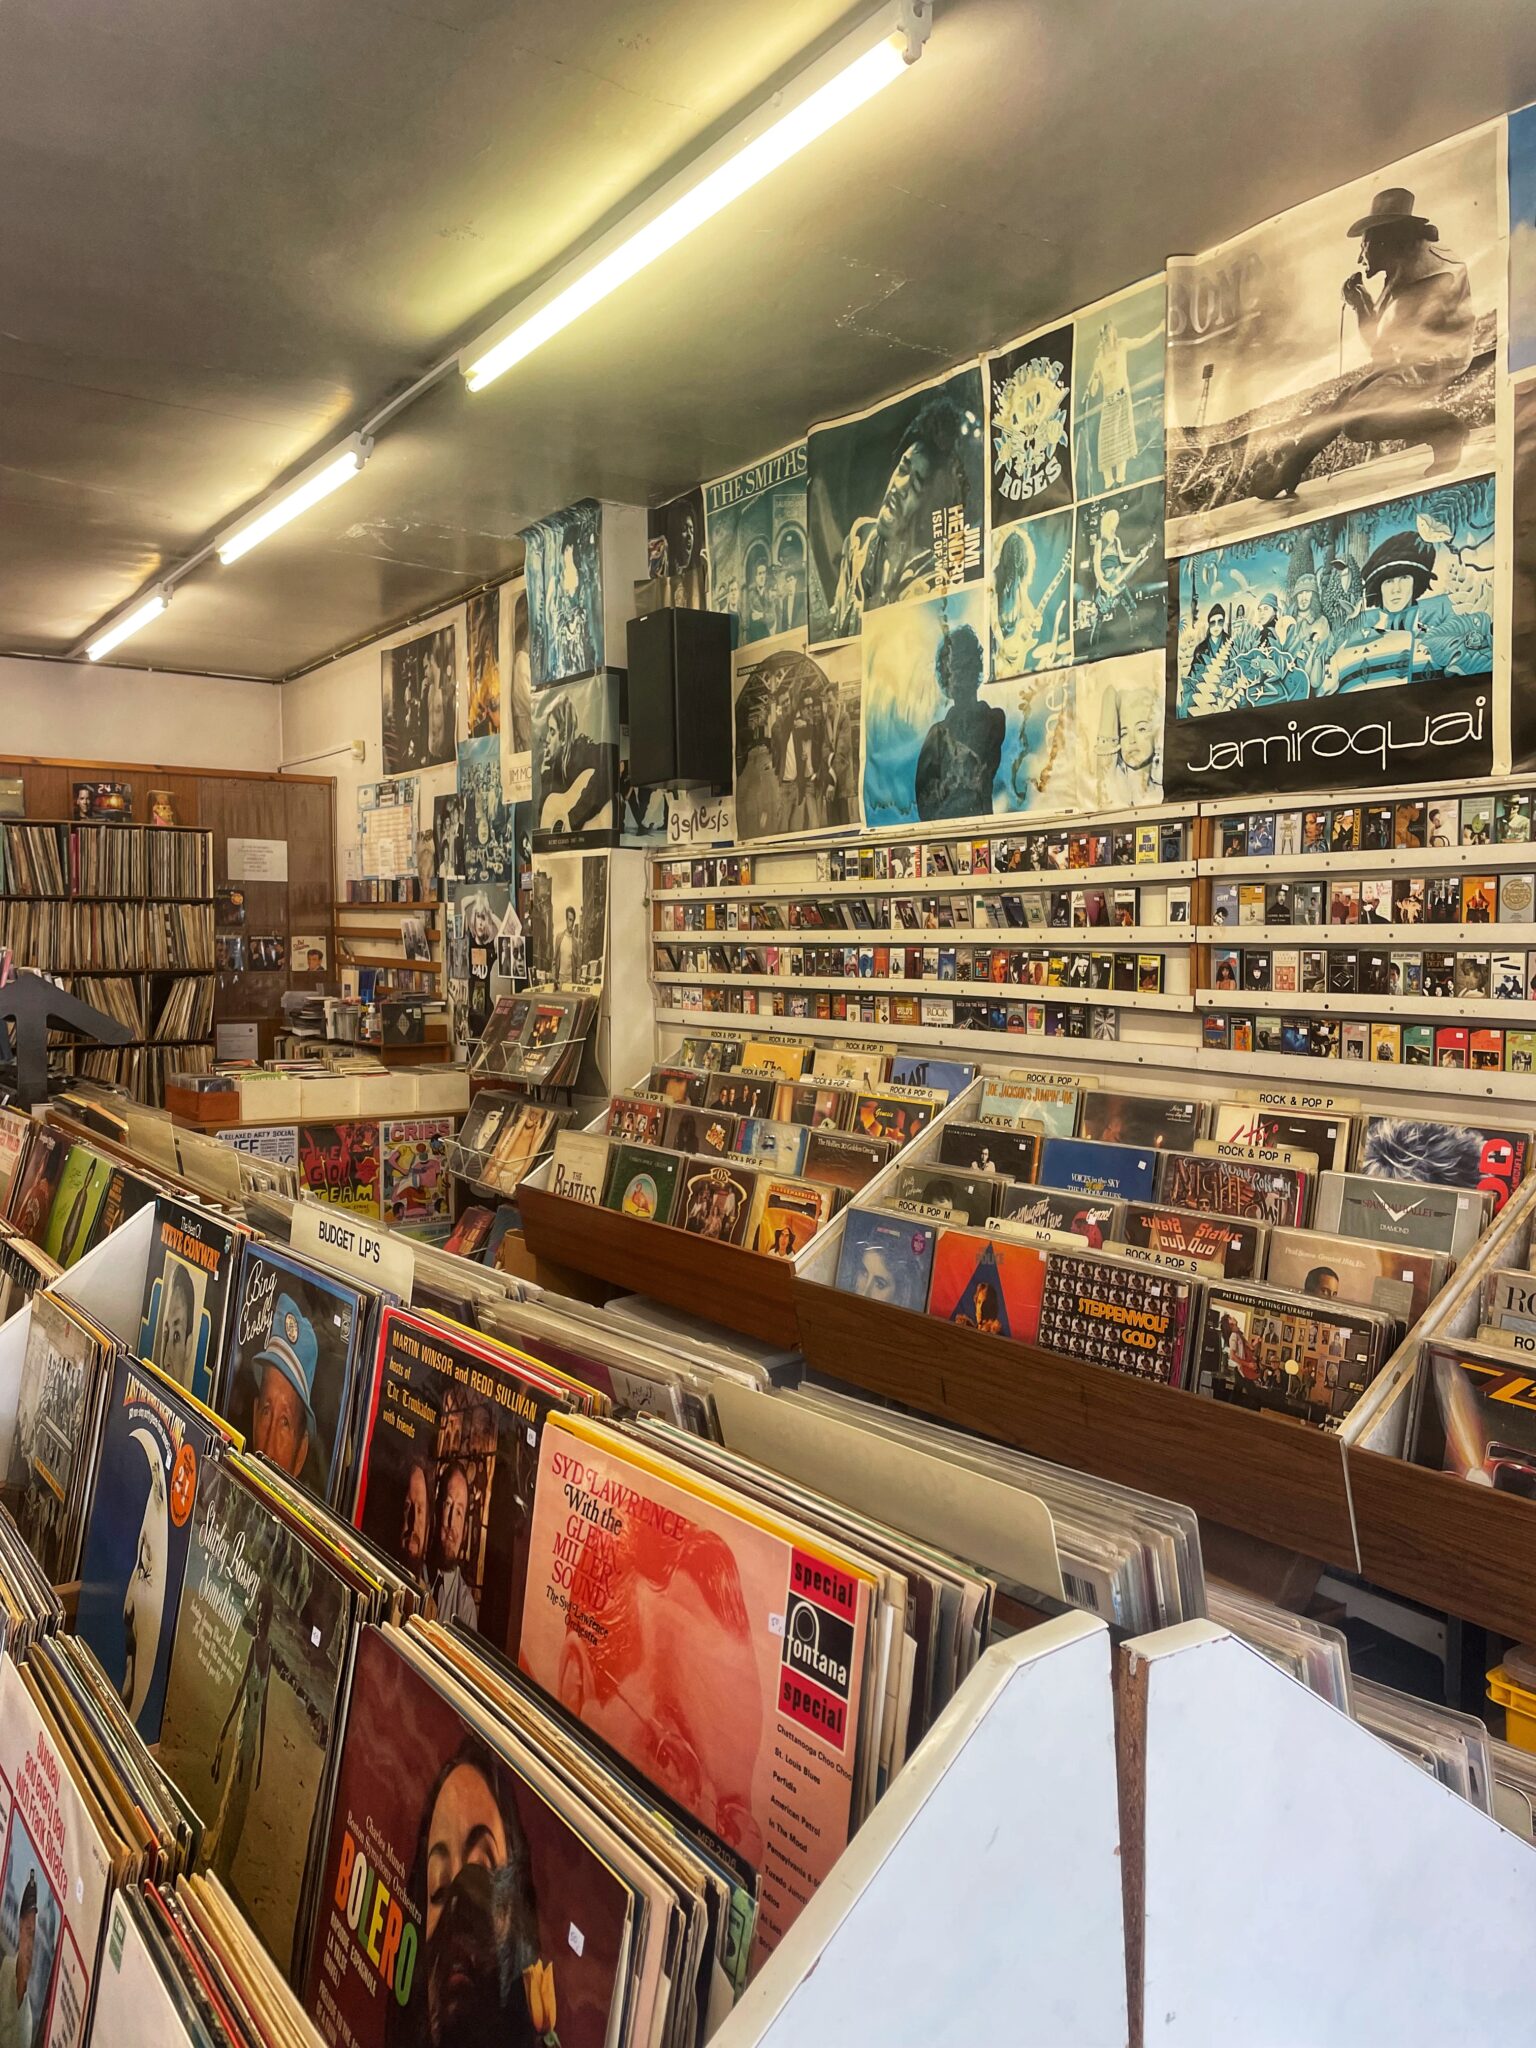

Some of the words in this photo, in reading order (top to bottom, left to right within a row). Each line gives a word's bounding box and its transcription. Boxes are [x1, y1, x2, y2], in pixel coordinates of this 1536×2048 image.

[710, 474, 743, 509] THE
[745, 446, 808, 494] SMITHS
[998, 456, 1062, 501] ROSES
[963, 523, 980, 569] JIMI
[670, 799, 729, 842] genesis
[890, 1086, 905, 1095] ROCK
[913, 1088, 925, 1097] POP
[985, 1082, 998, 1097] JOE
[999, 1082, 1032, 1100] JACKSON'S
[1026, 1073, 1046, 1083] ROCK
[1057, 1076, 1072, 1085] POP
[1259, 1093, 1286, 1106] ROCK
[1302, 1097, 1323, 1108] POP
[391, 1122, 451, 1142] CRIBS
[875, 1107, 894, 1118] Genesis
[224, 1132, 251, 1141] RELAXED
[253, 1130, 270, 1138] ARTY
[1217, 1144, 1244, 1157] ROCK
[1258, 1149, 1279, 1161] POP
[553, 1163, 597, 1205] BEATLES
[572, 1171, 582, 1181] THE
[1071, 1172, 1091, 1184] VOICES
[1107, 1178, 1120, 1188] SKY
[1511, 1140, 1525, 1194] AMOUFLAGE
[898, 1200, 917, 1211] ROCK
[926, 1207, 941, 1216] POP
[1379, 1223, 1410, 1234] DIAMOND
[161, 1222, 184, 1253] STEVE
[184, 1234, 220, 1273] CONWAY
[318, 1220, 355, 1252] BUDGET
[358, 1236, 380, 1263] LP'S
[1188, 1237, 1216, 1255] Quo
[1194, 1222, 1243, 1243] Status
[1125, 1248, 1152, 1261] ROCK
[1165, 1256, 1185, 1269] POP
[244, 1259, 278, 1311] Bing
[1222, 1291, 1232, 1299] PAT
[1232, 1293, 1256, 1305] TRAVERS
[1257, 1299, 1281, 1311] PUTTING
[1287, 1305, 1314, 1318] STRAIGHT
[238, 1300, 274, 1350] Crosby
[1077, 1298, 1169, 1335] STEPPENWOLF
[1121, 1328, 1157, 1350] GOLD
[392, 1329, 420, 1359] MARTIN
[421, 1345, 453, 1378] WINSOR
[454, 1362, 470, 1384] and
[470, 1368, 494, 1398] REDD
[495, 1383, 538, 1423] SULLIVAN
[404, 1366, 412, 1381] of
[395, 1416, 416, 1439] friends
[551, 1451, 585, 1486] SYD
[586, 1468, 687, 1541] LAWRENCE
[564, 1483, 600, 1525] With
[601, 1501, 623, 1536] the
[199, 1500, 230, 1577] Shirley
[566, 1514, 622, 1576] GLENN
[225, 1531, 261, 1611] Bassey
[551, 1560, 608, 1612] SOUND
[552, 1532, 614, 1600] MILLER
[794, 1560, 854, 1609] special
[546, 1585, 559, 1606] The
[559, 1594, 572, 1615] Syd
[572, 1603, 609, 1639] Lawrence
[564, 1613, 598, 1646] Orchestra
[786, 1600, 847, 1687] fontana
[783, 1681, 844, 1734] special
[36, 1730, 61, 1801] Sunday
[776, 1723, 817, 1758] Chattanooga
[817, 1750, 835, 1770] Choo
[835, 1762, 852, 1782] Choo
[785, 1753, 802, 1772] Louis
[803, 1765, 821, 1785] Blues
[24, 1750, 37, 1782] and
[37, 1772, 53, 1823] every
[52, 1805, 66, 1852] day
[772, 1770, 797, 1795] Perfidia
[768, 1817, 775, 1829] In
[776, 1822, 788, 1839] The
[789, 1833, 808, 1854] Mood
[770, 1794, 800, 1823] American
[801, 1814, 821, 1838] Patrol
[28, 1794, 47, 1844] Frank
[45, 1829, 69, 1900] Sinatra
[346, 1809, 365, 1845] Boston
[364, 1834, 392, 1886] Symphony
[392, 1875, 422, 1926] Orchestra
[365, 1814, 385, 1851] Charles
[386, 1841, 406, 1880] Munch
[334, 1830, 418, 2008] BOLERO
[762, 1888, 780, 1909] Adios
